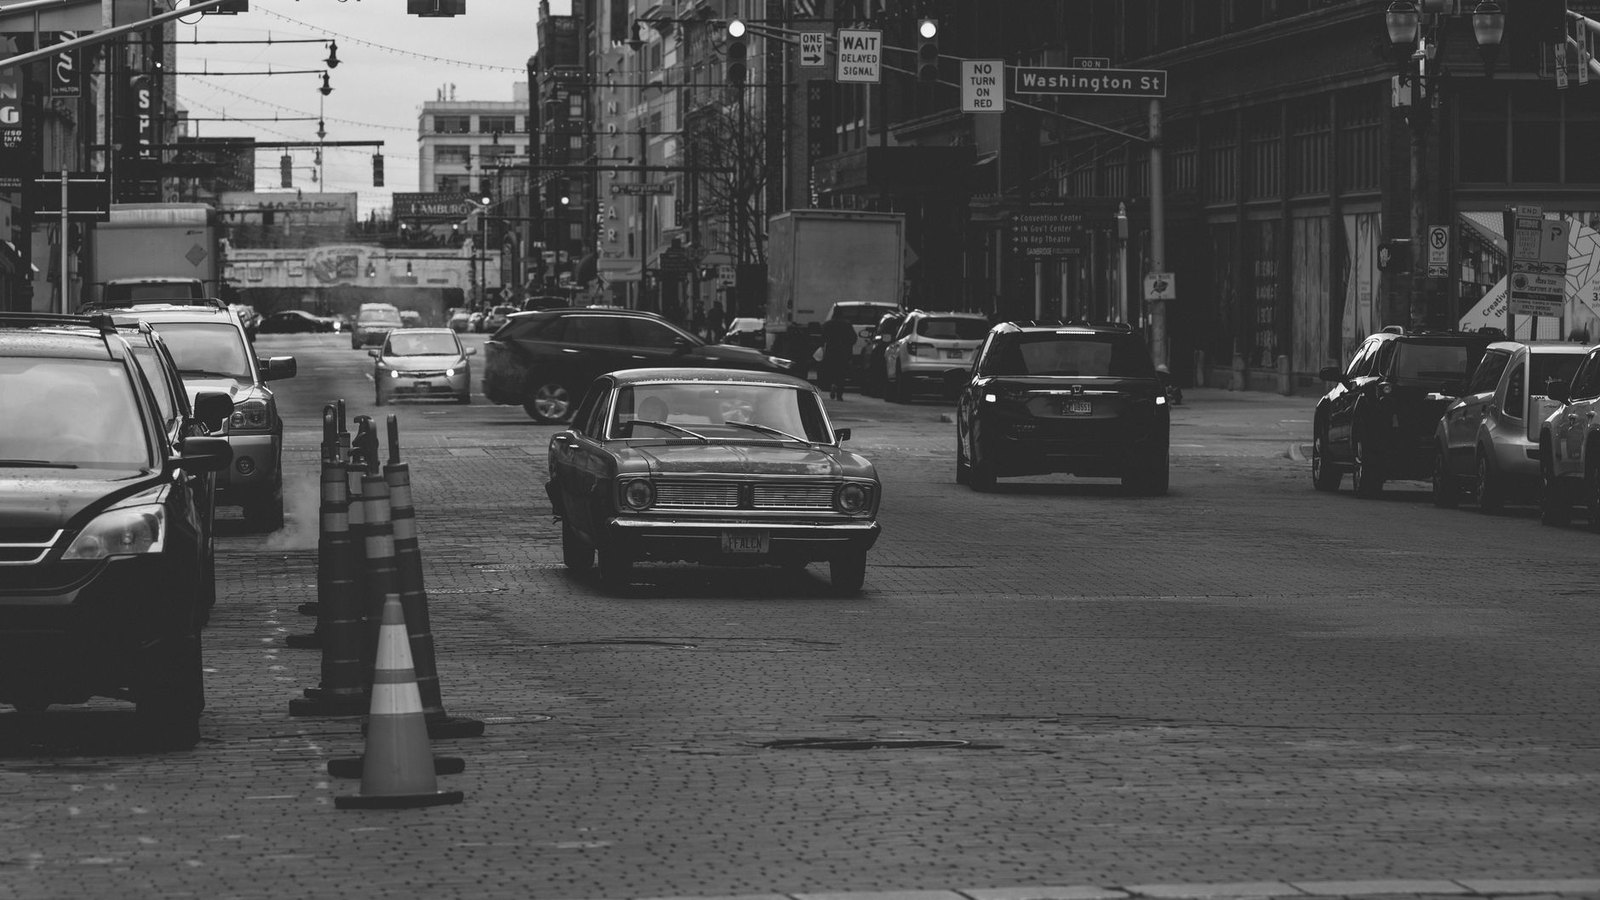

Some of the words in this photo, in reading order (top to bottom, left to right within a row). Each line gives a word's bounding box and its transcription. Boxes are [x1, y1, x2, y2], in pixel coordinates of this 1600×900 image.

[803, 34, 822, 43] ONE
[843, 36, 877, 50] WAIT
[803, 44, 822, 53] WAY
[841, 53, 878, 63] DELAYED
[843, 66, 874, 76] SIGNAL
[974, 64, 993, 75] NO
[969, 76, 996, 86] TURN
[1023, 73, 1133, 93] Washington
[1140, 76, 1160, 91] St
[976, 88, 991, 98] ON
[973, 99, 993, 109] RED
[1521, 207, 1538, 216] END
[1020, 214, 1058, 223] Convention
[1060, 214, 1082, 223] Center
[1020, 225, 1028, 233] IN
[1050, 224, 1072, 233] Center
[1020, 236, 1028, 244] IN
[1482, 289, 1510, 317] Creative
[1494, 305, 1508, 318] the
